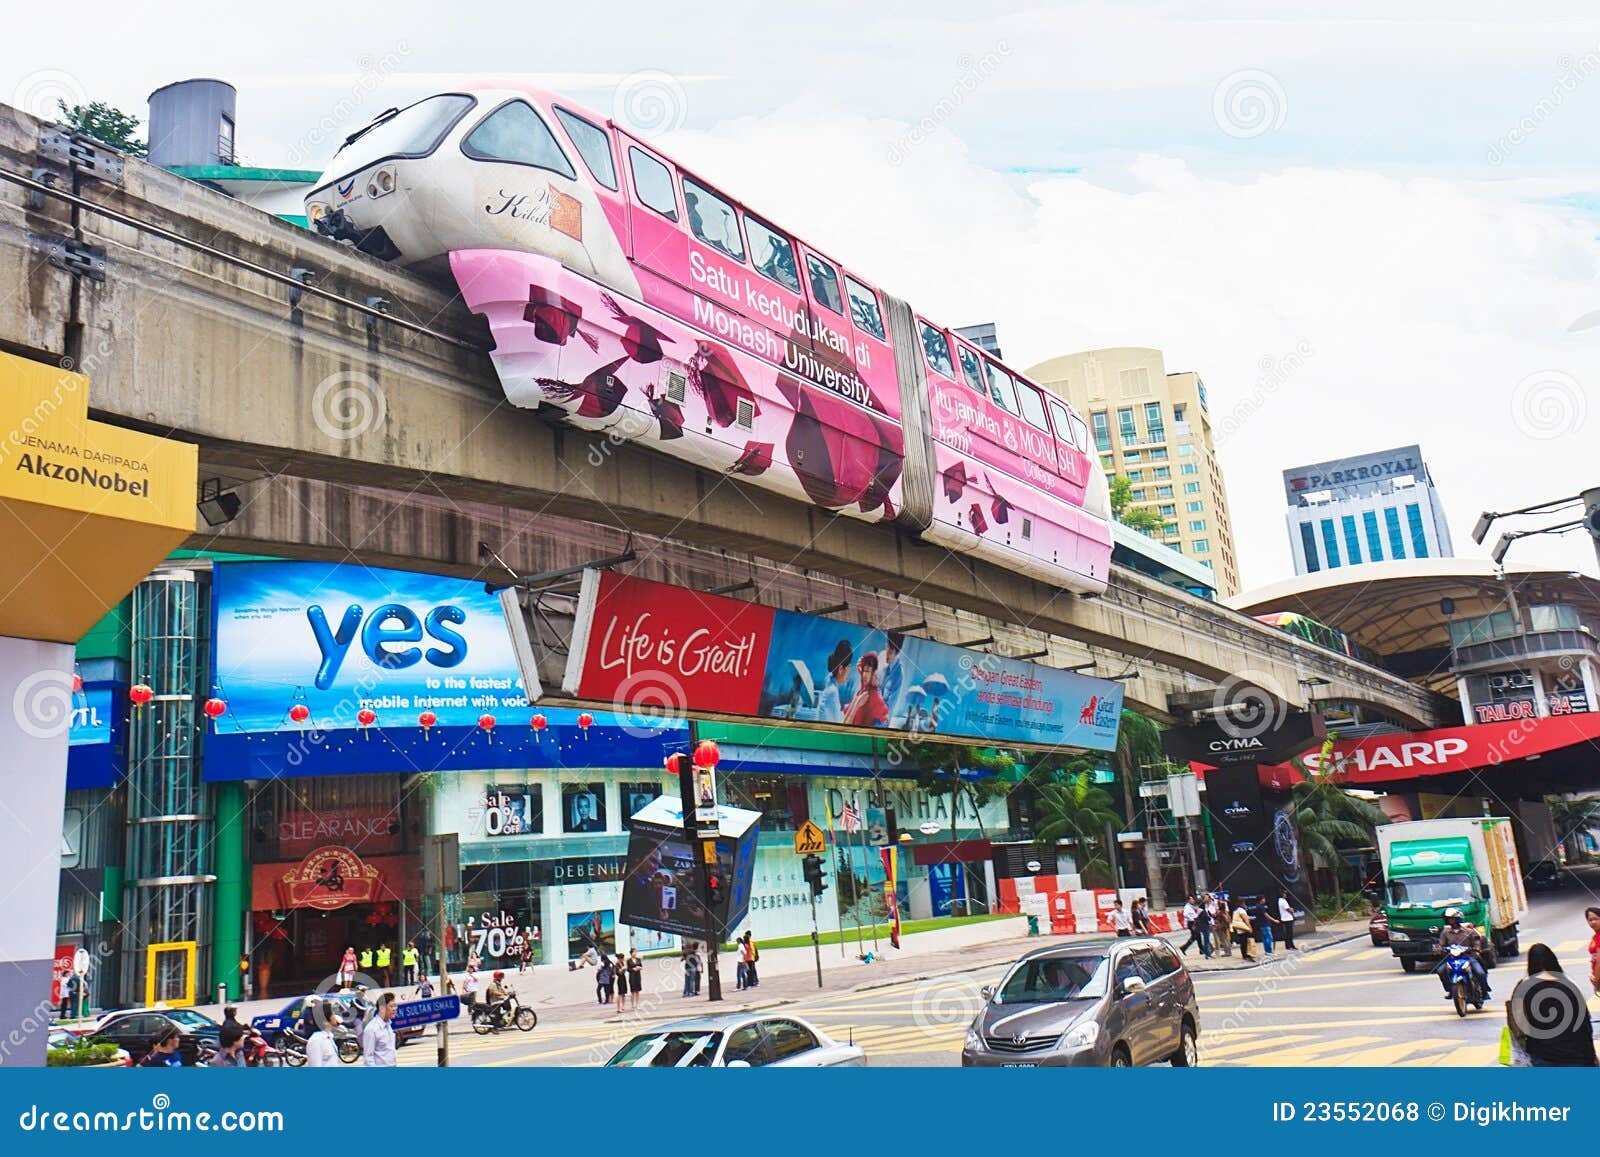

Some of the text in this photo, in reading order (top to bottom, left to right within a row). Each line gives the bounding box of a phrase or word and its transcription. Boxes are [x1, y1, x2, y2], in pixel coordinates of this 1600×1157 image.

[690, 250, 872, 369] Satu kedudukan di
[693, 296, 873, 407] Monash University.
[934, 383, 1001, 438] Itu jaminan
[20, 435, 149, 473] JENAMA DARIPADA
[1018, 425, 1076, 477] MONASH
[16, 453, 149, 498] AkzoNobel
[1310, 458, 1418, 489] PARKROYAL
[306, 603, 468, 691] yes
[600, 612, 756, 680] Life is Great!
[426, 677, 441, 690] to
[445, 677, 467, 690] the
[469, 676, 512, 690] fastest
[359, 695, 410, 710] mobile
[413, 695, 468, 708] internet
[471, 694, 499, 708] with
[1475, 700, 1536, 723] TAILOR
[1550, 695, 1572, 715] 24
[1208, 737, 1264, 751] CYMA
[1302, 738, 1469, 776] SHARP
[480, 791, 511, 807] Sale
[1224, 806, 1251, 814] CYMA
[503, 824, 521, 835] OFF
[751, 891, 824, 911] DEBENHAS
[480, 910, 515, 929] Sale
[471, 926, 524, 958] 70%
[506, 946, 524, 956] OFF
[406, 1003, 432, 1017] SULTAN
[432, 999, 455, 1011] ISMAIL
